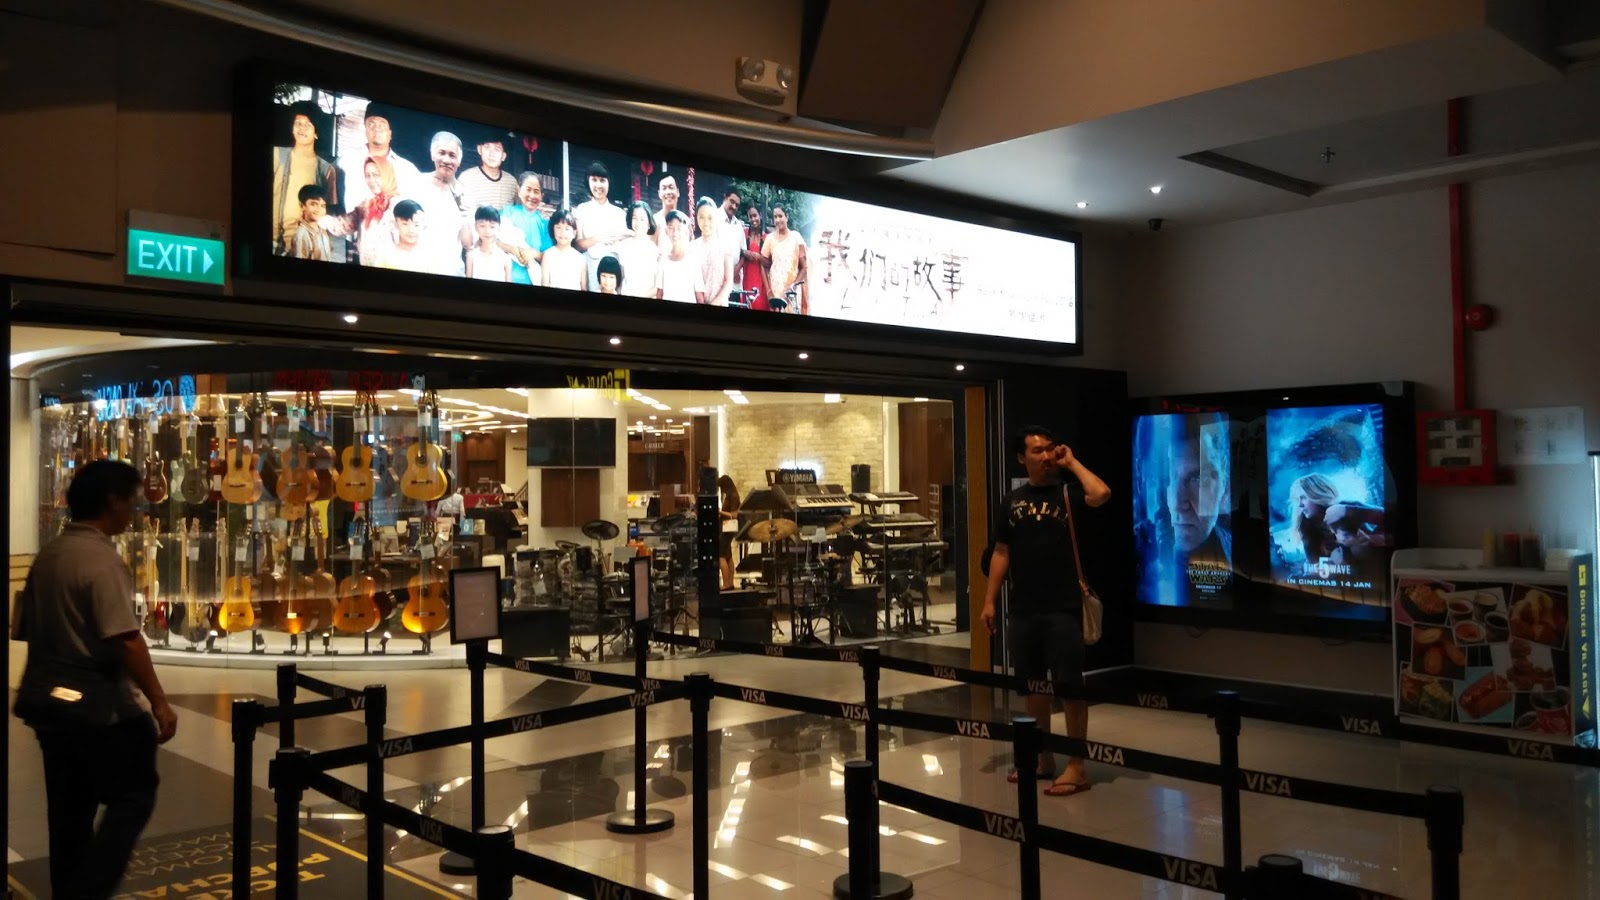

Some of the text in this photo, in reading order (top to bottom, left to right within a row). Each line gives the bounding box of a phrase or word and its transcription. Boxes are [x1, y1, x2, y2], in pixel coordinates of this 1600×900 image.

[138, 239, 198, 273] EXIT
[818, 229, 968, 304] 我们的故事
[789, 473, 814, 482] YAMAHA
[1319, 556, 1330, 579] 5
[1331, 564, 1351, 575] WAVE
[1189, 574, 1228, 585] WARS
[1298, 579, 1337, 587] CINEMAS
[700, 638, 716, 649] VISA
[765, 645, 784, 657] VISA
[514, 658, 531, 671] VISA
[839, 651, 860, 662] VISA
[573, 669, 592, 682] VISA
[933, 665, 957, 680] VISA
[640, 677, 661, 690] VISA
[1027, 679, 1055, 695] VISA
[350, 696, 367, 711] VI
[628, 690, 655, 708] VISA
[741, 688, 767, 704] VISA
[1137, 692, 1169, 709] VISA
[841, 704, 870, 721] VISA
[511, 714, 543, 732] VISA
[956, 719, 991, 739] VISA
[1340, 713, 1382, 736] VISA
[376, 737, 414, 759] VISA
[1085, 742, 1125, 766] VISA
[1506, 738, 1554, 761] VISA
[1242, 771, 1292, 797] VISA
[983, 812, 1026, 842] VISA
[1160, 855, 1219, 890] VISA
